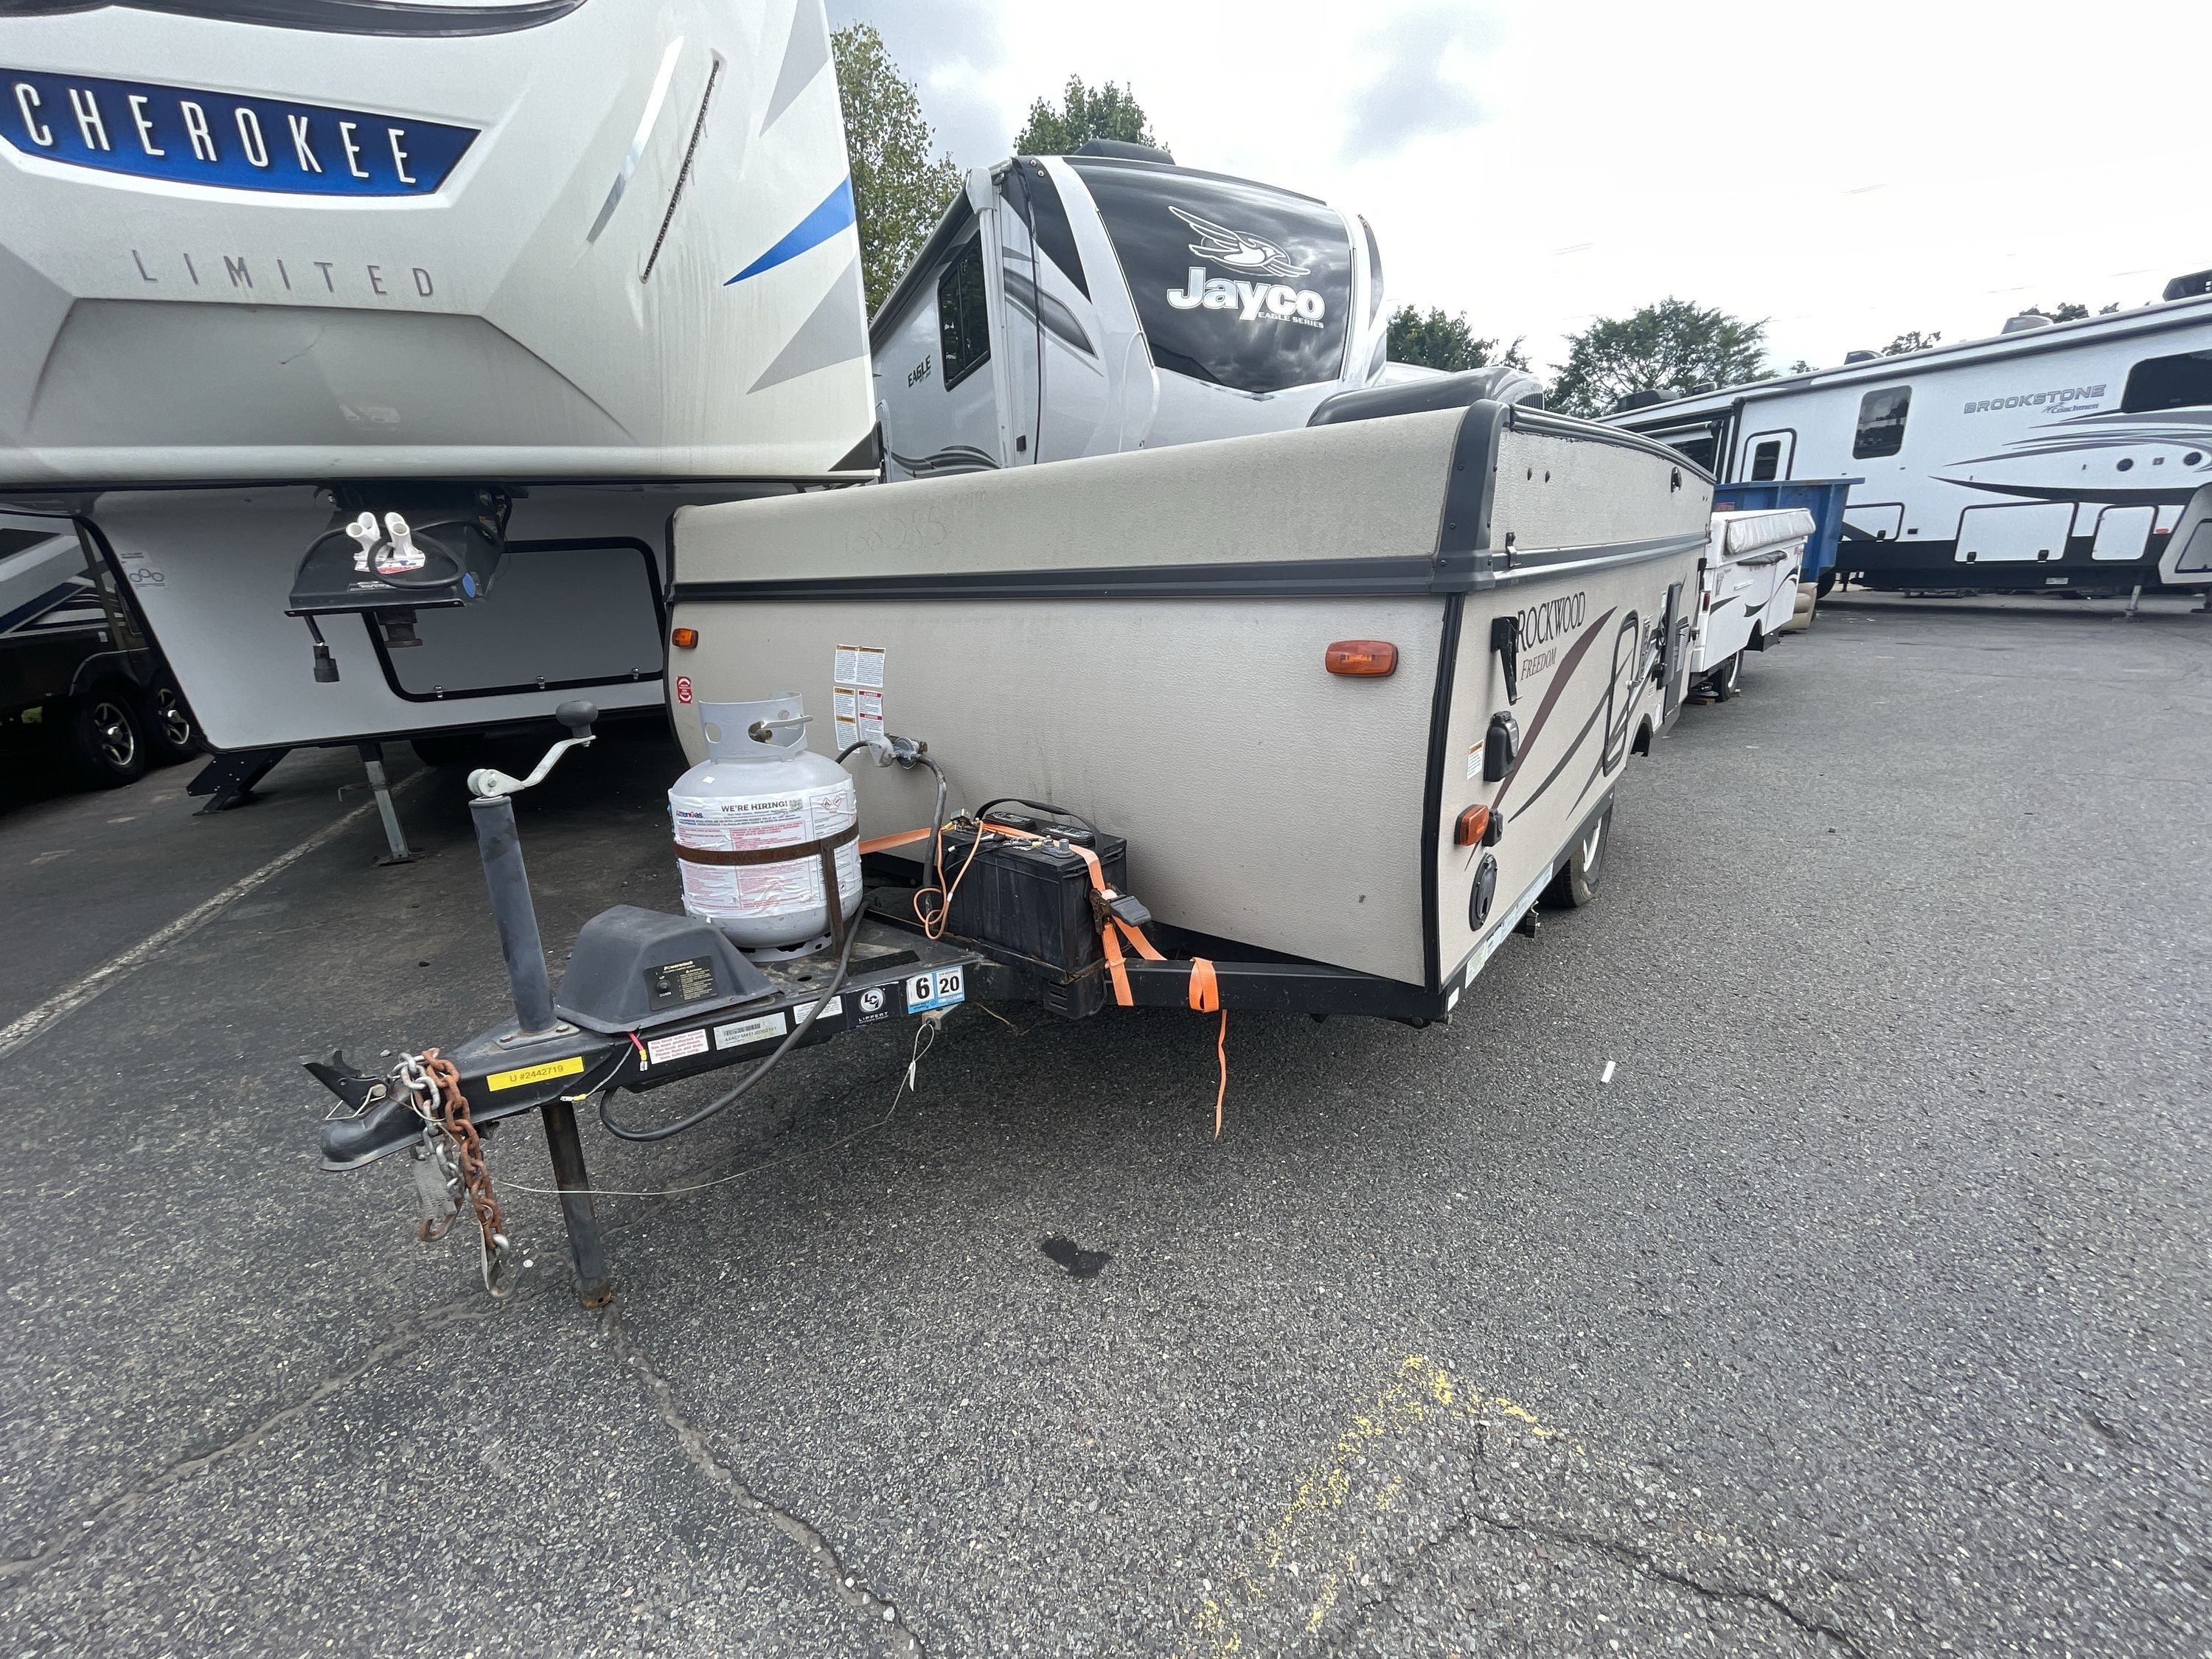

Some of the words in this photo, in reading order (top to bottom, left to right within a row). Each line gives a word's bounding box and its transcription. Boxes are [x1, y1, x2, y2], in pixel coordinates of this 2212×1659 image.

[15, 83, 417, 184] CHEROKEE
[131, 249, 435, 298] LIMITED
[1167, 266, 1325, 321] Jayco
[1258, 311, 1291, 322] EAGLE
[1292, 316, 1324, 329] SERIES
[908, 354, 931, 389] EAGLE
[1964, 383, 2107, 414] BROOKSTONE
[1516, 591, 1585, 653] ROCKWOOD
[1520, 647, 1557, 681] FREEDOM
[751, 800, 788, 810] HIRING!
[916, 977, 931, 1000] 6
[939, 975, 960, 995] 20
[858, 1011, 889, 1022] LIPPERT
[509, 1074, 517, 1082] U
[520, 1065, 563, 1080] #2442719
